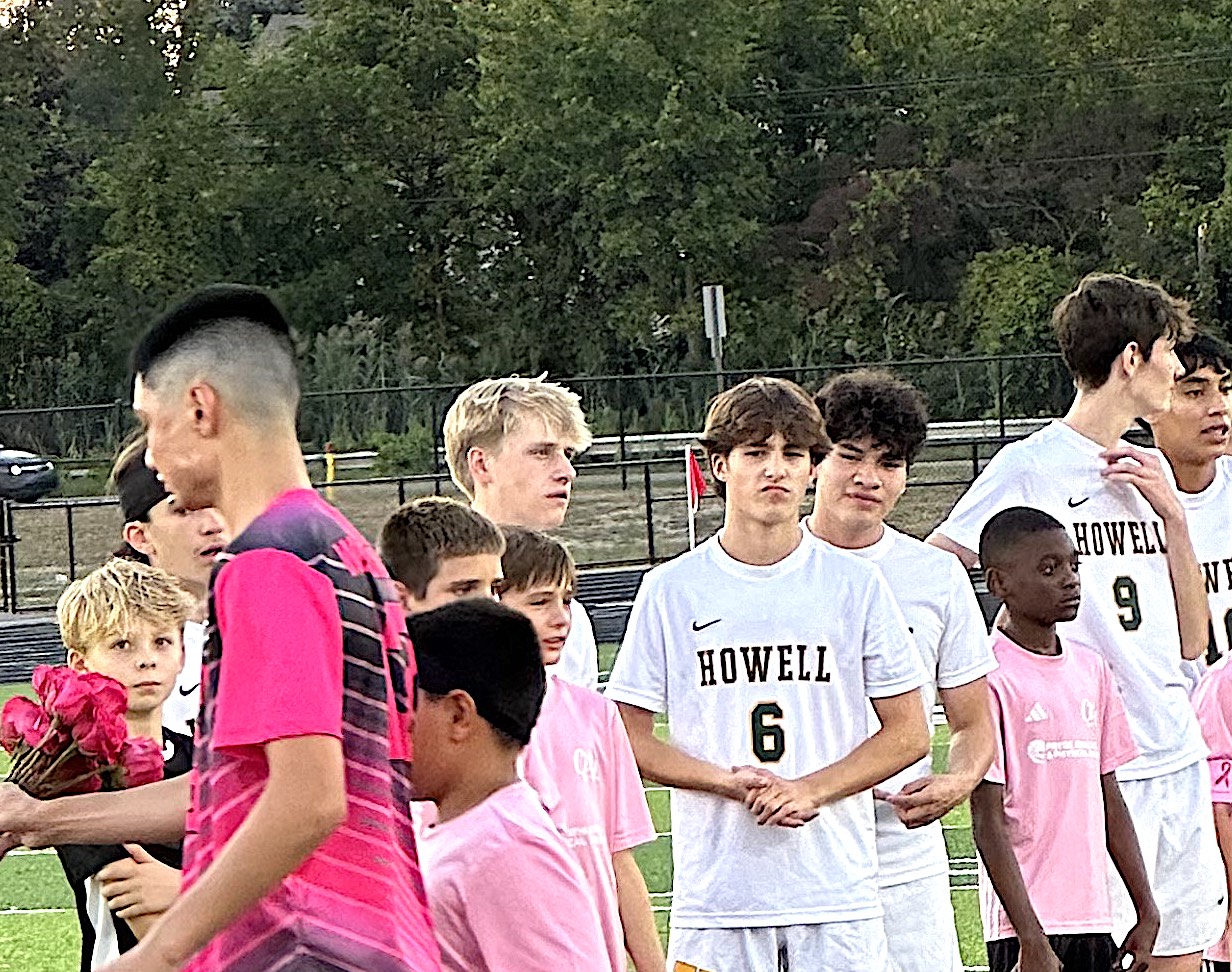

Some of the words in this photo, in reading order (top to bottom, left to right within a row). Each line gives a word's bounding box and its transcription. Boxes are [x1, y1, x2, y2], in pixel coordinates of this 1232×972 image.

[1072, 520, 1169, 556] HOWELL
[1113, 575, 1142, 632] 9
[696, 644, 831, 687] HOWELL
[750, 701, 786, 763] 6
